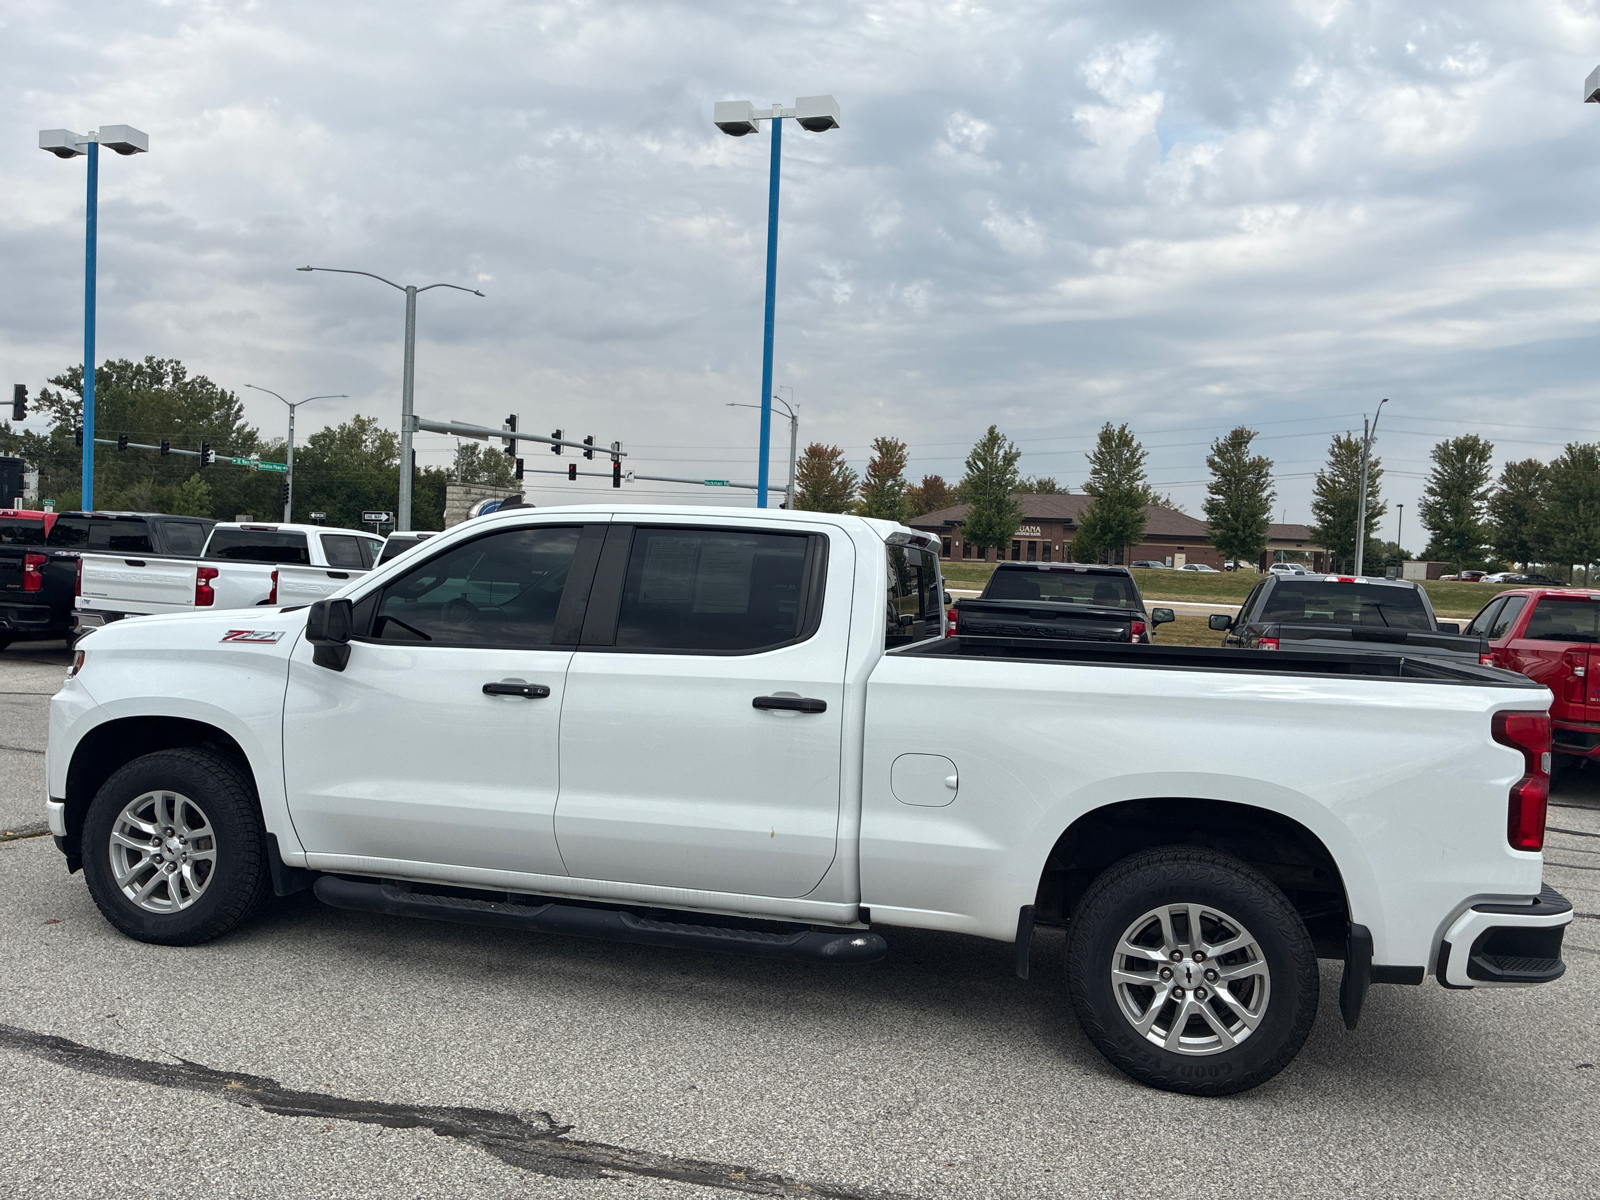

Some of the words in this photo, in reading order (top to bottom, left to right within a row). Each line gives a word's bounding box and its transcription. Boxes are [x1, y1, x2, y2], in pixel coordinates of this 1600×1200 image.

[1016, 525, 1041, 533] UANA
[86, 569, 186, 585] CHEVROLET
[284, 583, 341, 594] CHEVR
[219, 629, 286, 644] Z71
